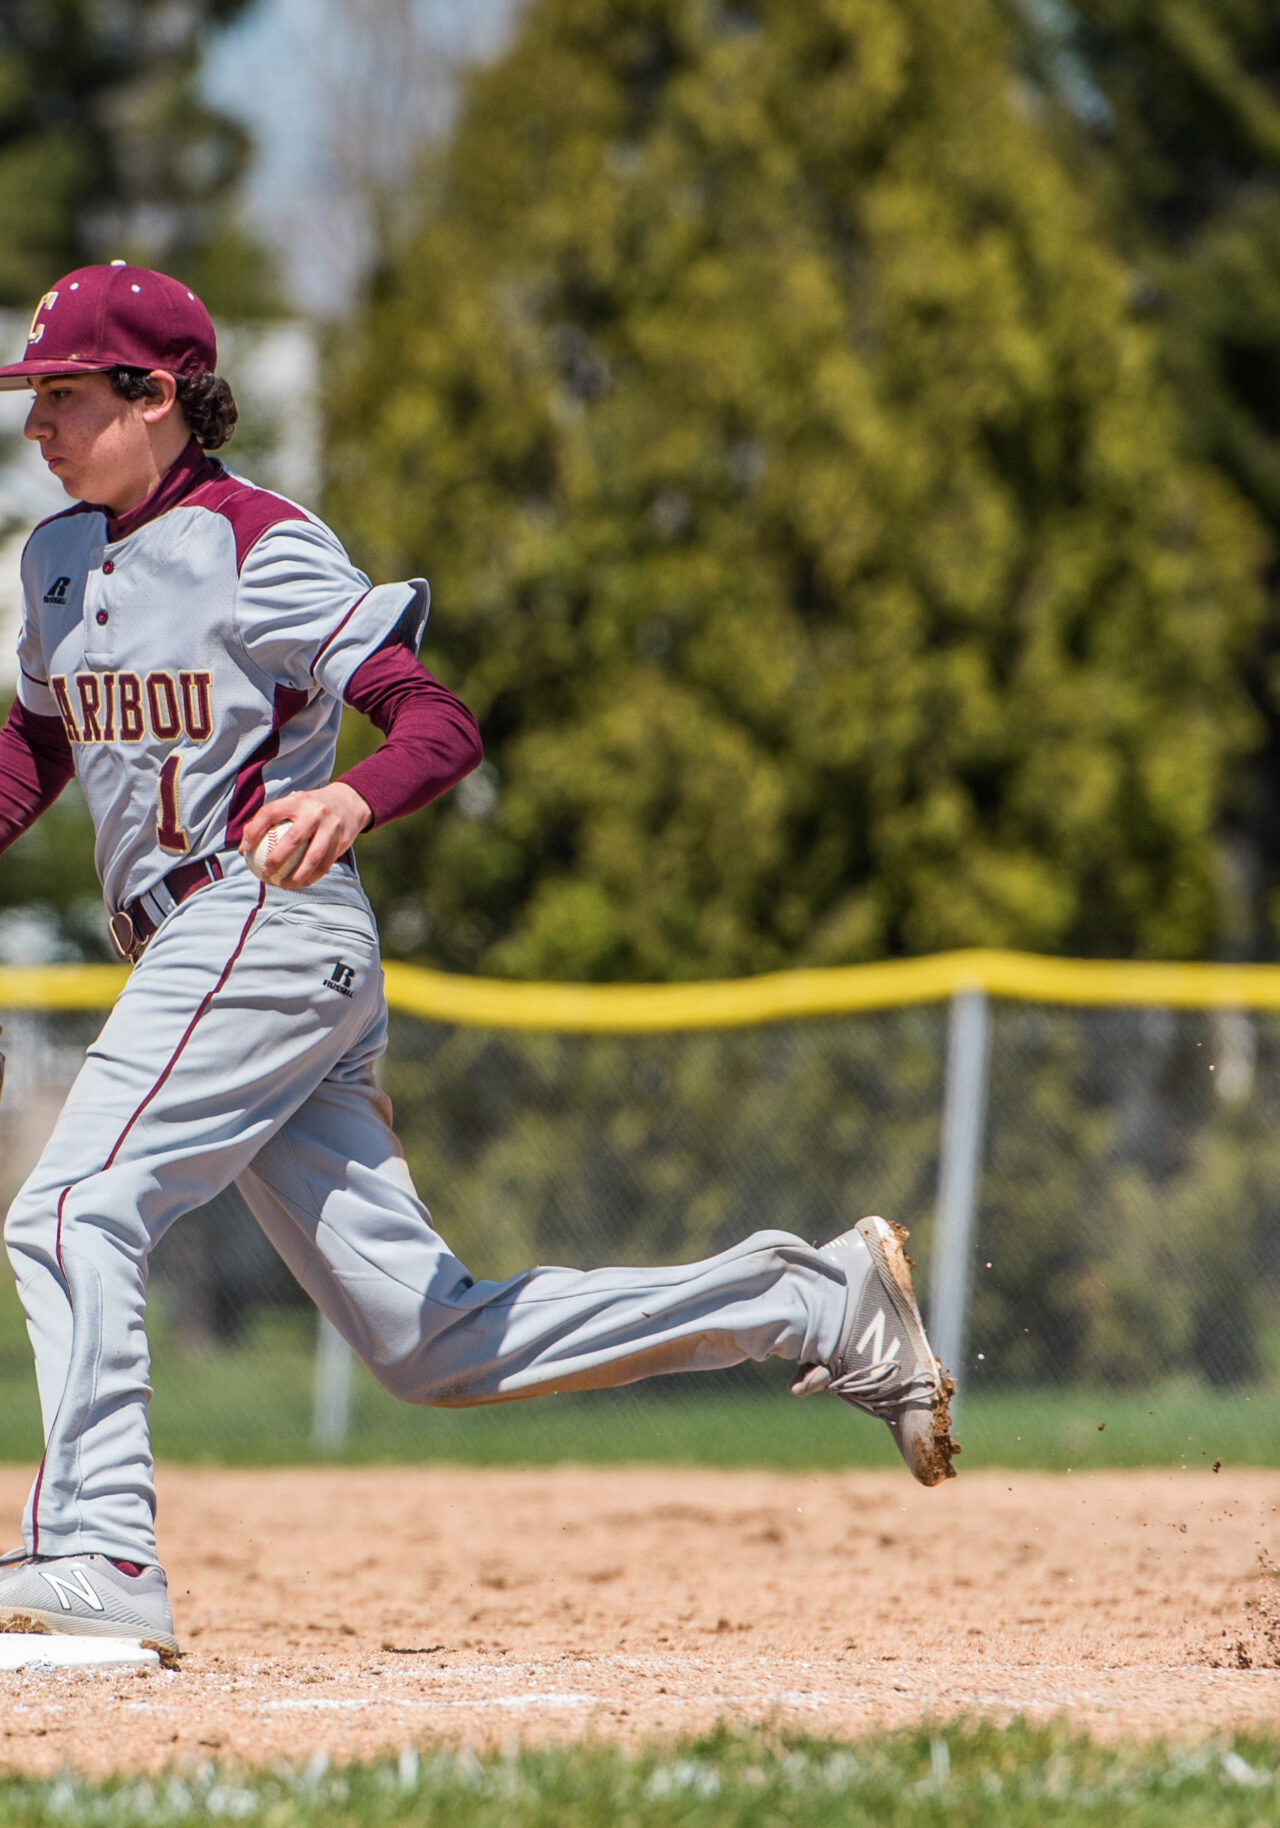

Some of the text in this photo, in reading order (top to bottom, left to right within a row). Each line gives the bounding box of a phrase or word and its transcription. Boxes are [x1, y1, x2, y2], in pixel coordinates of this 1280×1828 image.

[28, 291, 59, 344] C
[50, 670, 214, 744] ARIBOU
[156, 752, 191, 853] 1
